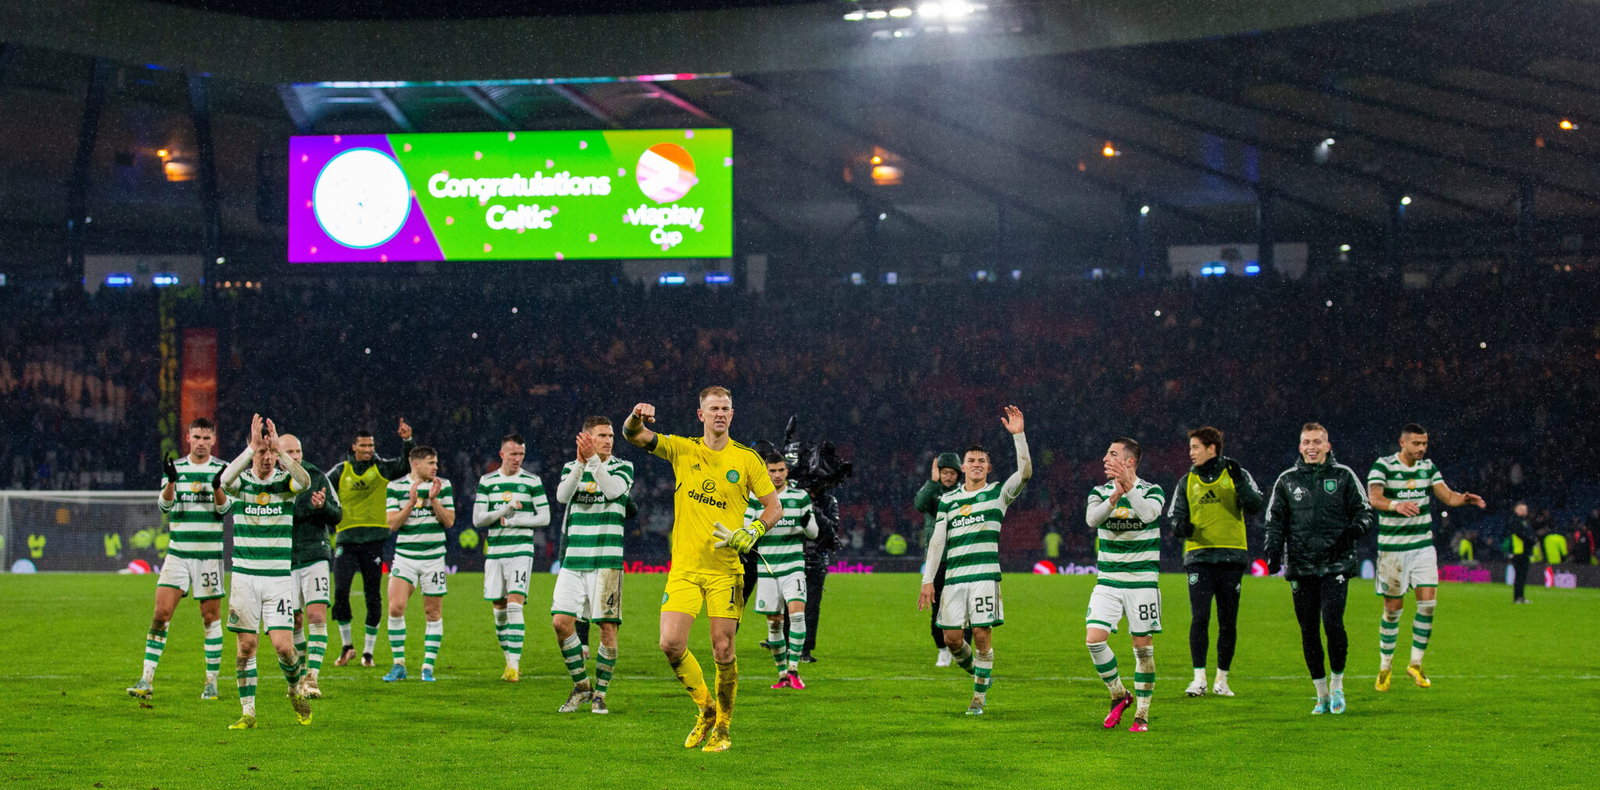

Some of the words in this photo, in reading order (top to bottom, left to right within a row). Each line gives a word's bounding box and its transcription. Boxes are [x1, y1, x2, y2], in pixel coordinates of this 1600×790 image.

[428, 171, 611, 203] Congratulations
[486, 204, 553, 230] Celtic
[627, 204, 704, 228] viaplay
[650, 228, 683, 247] Cup
[180, 493, 213, 503] dafabet
[688, 489, 728, 510] dafabet
[1397, 489, 1426, 499] dafabet
[244, 505, 283, 516] dafabet
[951, 513, 985, 528] dafabet
[1105, 518, 1143, 531] dafabet
[201, 572, 219, 587] 33
[315, 576, 329, 592] 13
[431, 571, 446, 585] 49
[515, 570, 527, 583] 14
[606, 593, 614, 608] 4
[729, 586, 735, 604] 1
[276, 599, 293, 616] 42
[975, 596, 994, 612] 25
[1139, 603, 1158, 621] 88
